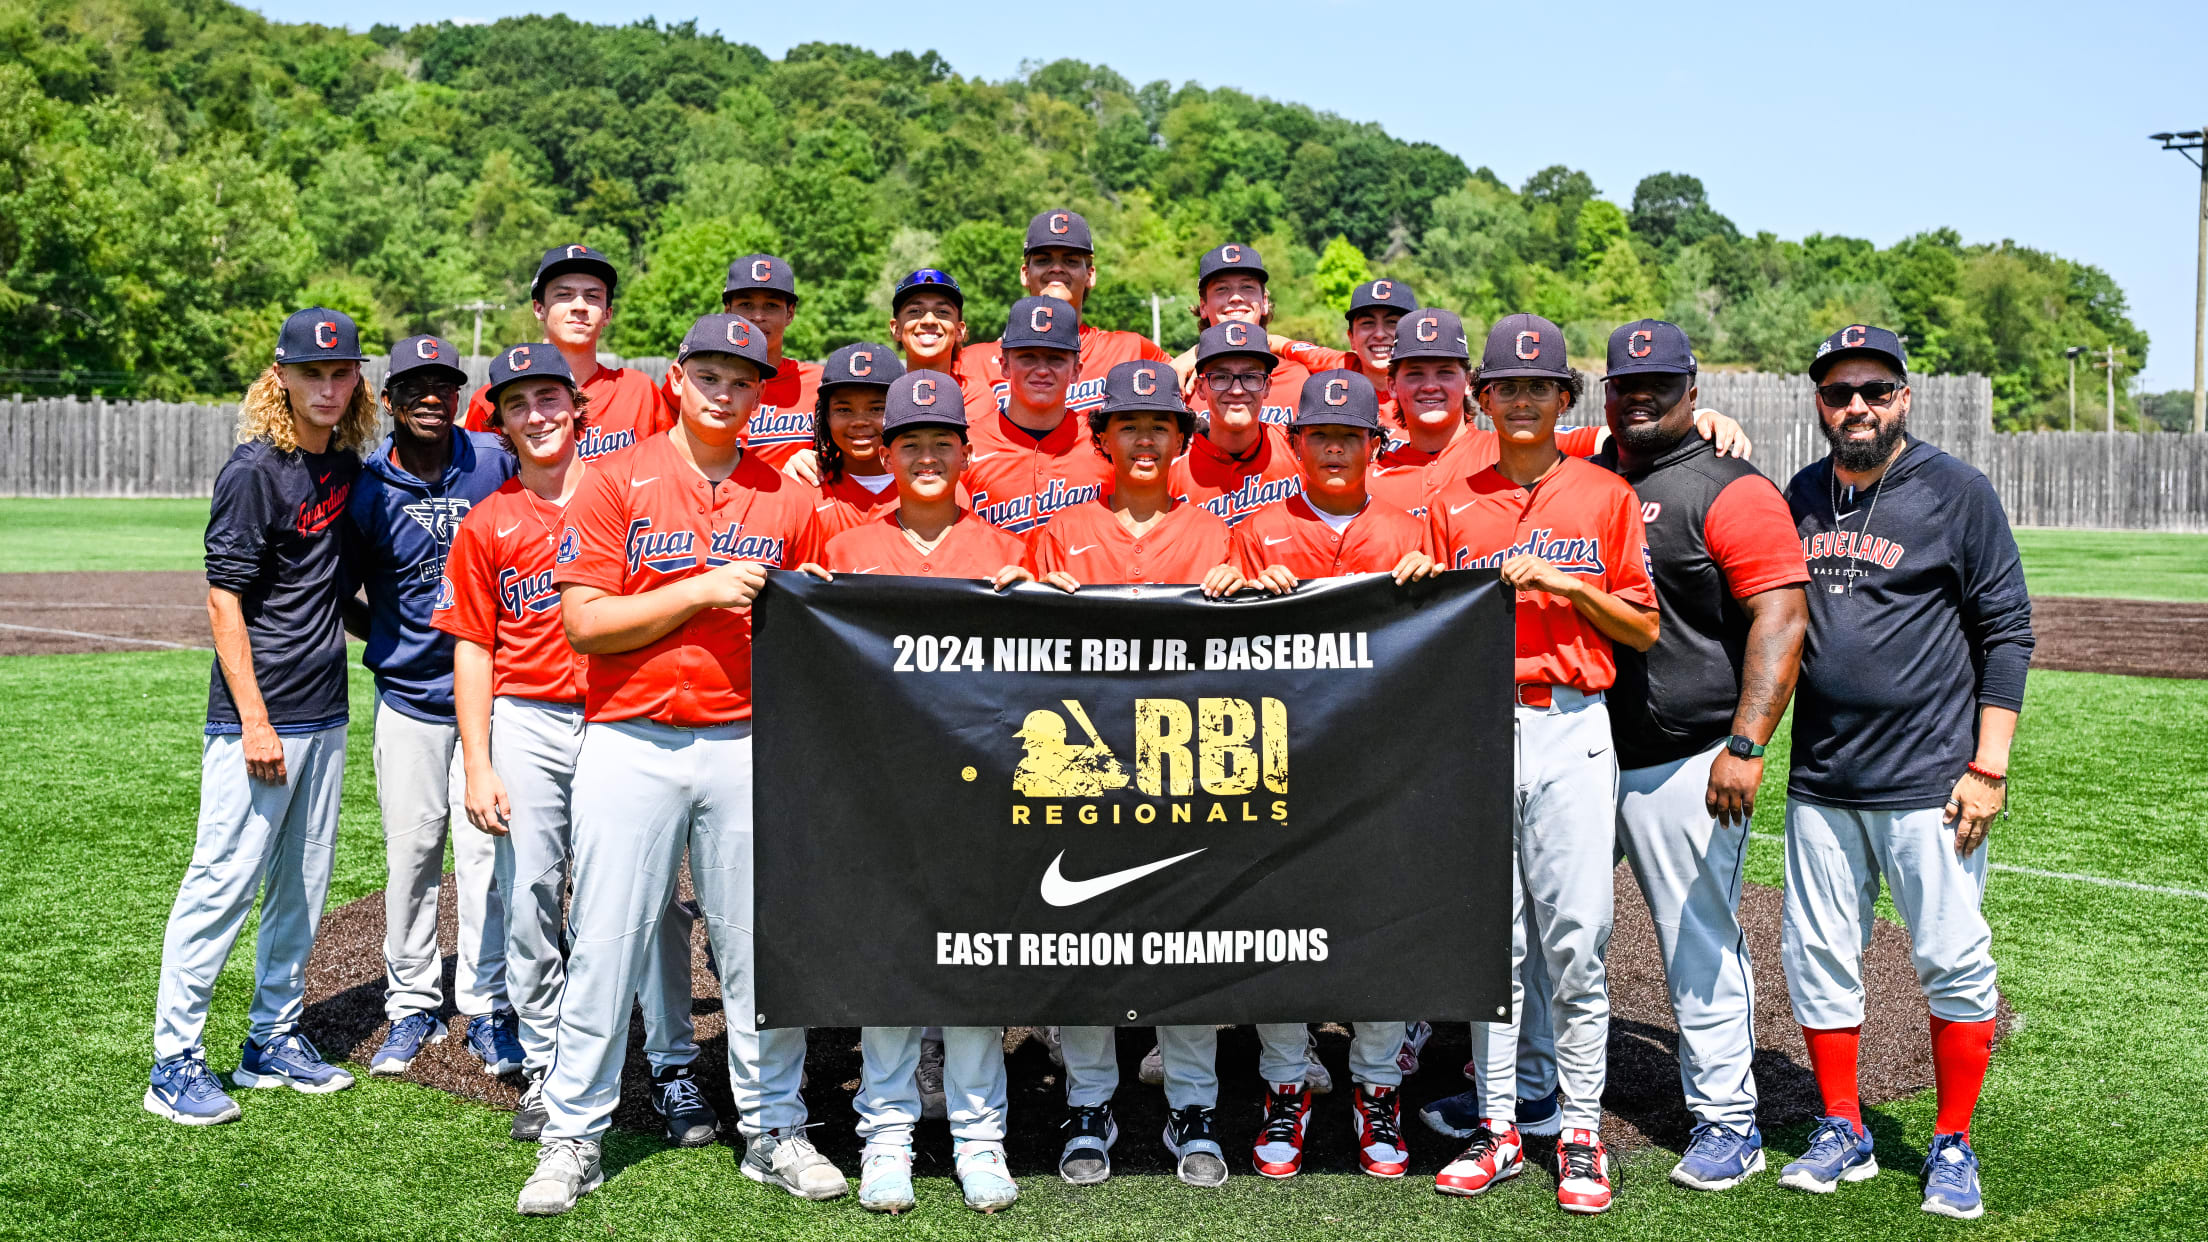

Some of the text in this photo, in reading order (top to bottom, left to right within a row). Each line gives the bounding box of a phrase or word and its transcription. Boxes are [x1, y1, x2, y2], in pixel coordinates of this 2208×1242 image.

[1049, 213, 1069, 234] C
[1221, 245, 1241, 263] C
[751, 260, 771, 282] C
[1371, 280, 1393, 300] C
[1031, 306, 1053, 333] C
[1416, 317, 1438, 342] C
[315, 322, 338, 349] C
[727, 321, 750, 347] C
[1225, 323, 1247, 346] C
[1516, 330, 1540, 361] C
[1628, 330, 1652, 358] C
[1841, 326, 1866, 348] C
[417, 339, 438, 359] C
[508, 347, 531, 372] C
[849, 351, 873, 377] C
[912, 379, 937, 406] C
[1133, 368, 1157, 396] C
[1324, 378, 1349, 406] C
[1801, 531, 1904, 570] LEVELAND
[894, 631, 1374, 673] 2024 NIKE RBI JR. BASEBALL
[1134, 696, 1289, 797] RBI
[1012, 800, 1288, 825] REGIONALS
[936, 927, 1329, 967] EAST REGION CHAMPIONS
